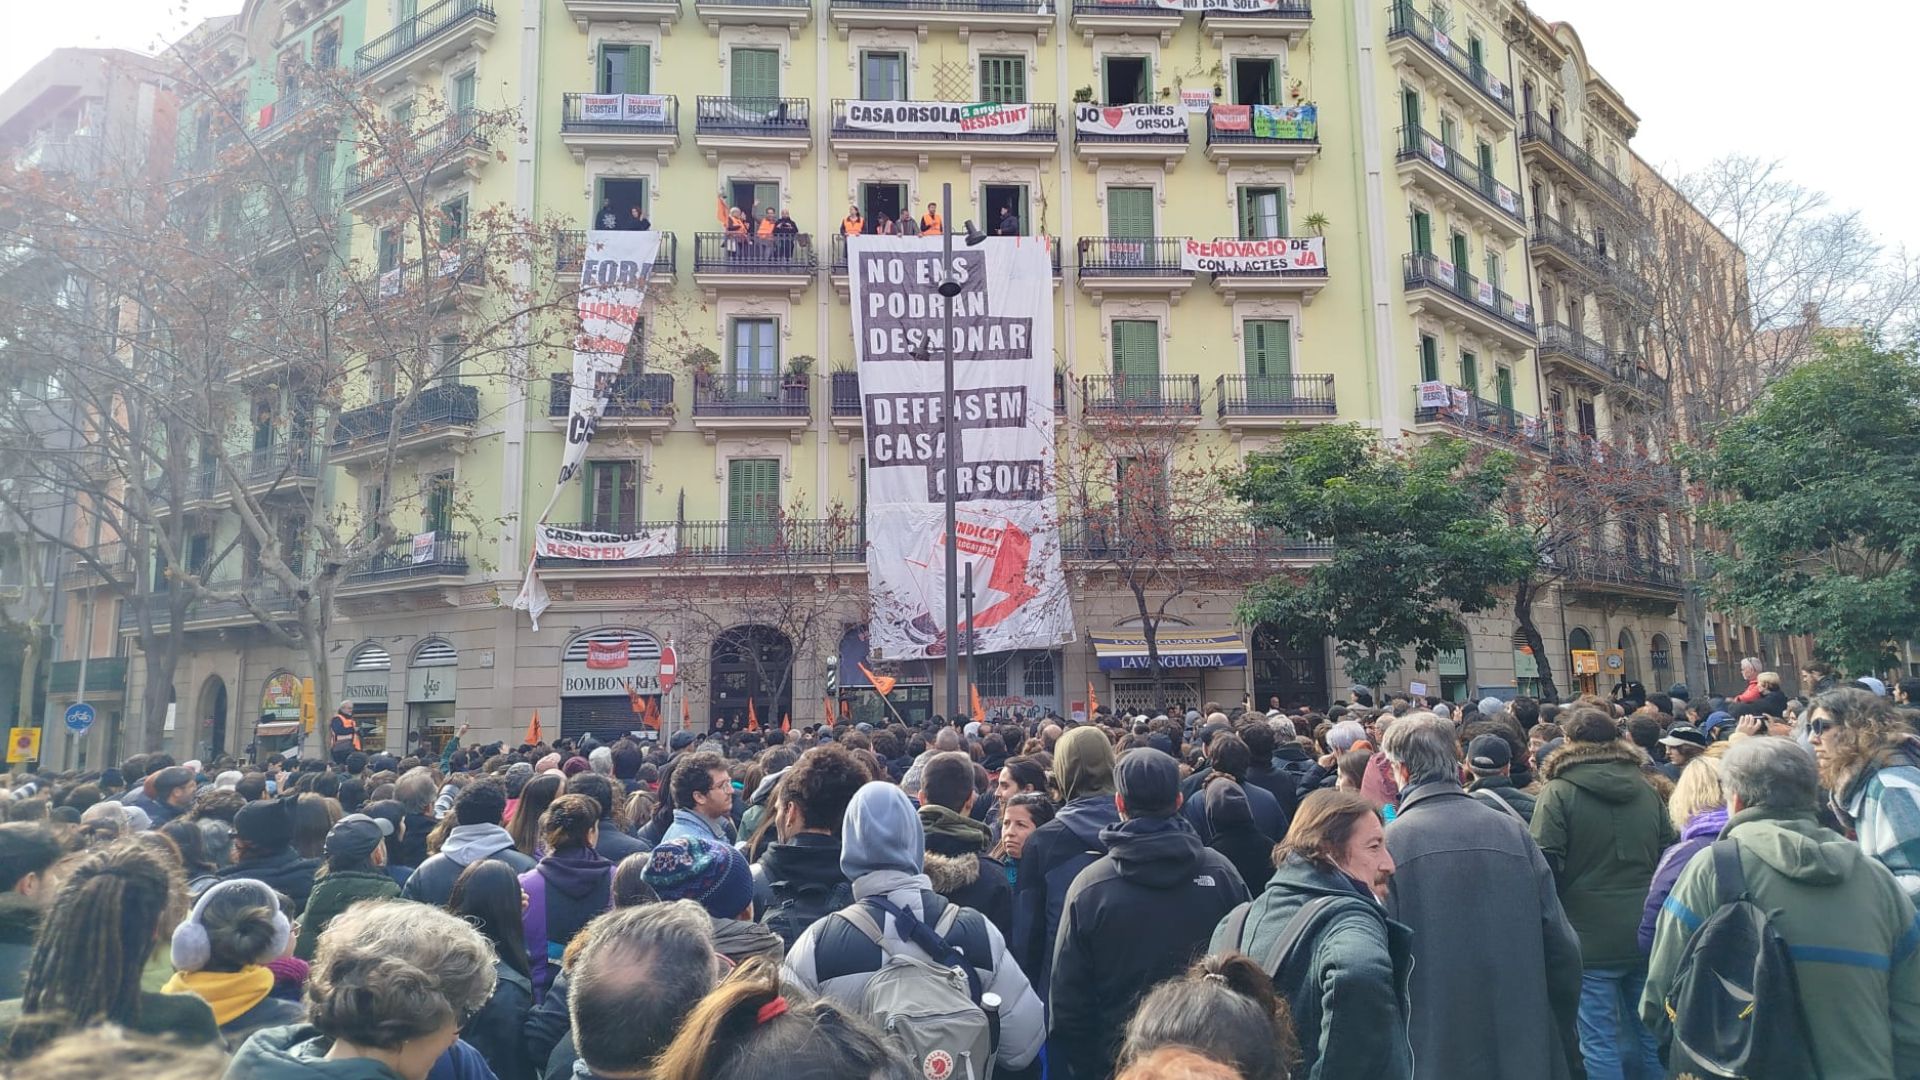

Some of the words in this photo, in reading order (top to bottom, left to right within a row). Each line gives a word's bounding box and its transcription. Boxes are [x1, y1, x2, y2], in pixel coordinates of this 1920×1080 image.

[1233, 0, 1260, 9] SOLA
[850, 106, 895, 123] CASA
[896, 106, 961, 123] ORSOLA
[960, 106, 1028, 132] RESISTINT
[961, 107, 970, 118] 2
[973, 106, 1002, 117] anys
[1076, 107, 1100, 123] JO
[1135, 117, 1186, 130] ORSOLA
[1291, 240, 1310, 251] DE
[1295, 251, 1318, 267] JA
[867, 258, 904, 285] NO
[916, 257, 968, 284] ENS
[869, 291, 985, 318] PODRAN
[869, 323, 1026, 355] DESNONAR
[875, 431, 947, 462] CASA
[936, 464, 1041, 495] ORSOLA
[545, 528, 585, 542] CASA
[588, 529, 651, 544] ORSOLA
[954, 520, 1003, 542] INDICAT
[546, 543, 626, 559] RESISTEIX
[1128, 637, 1217, 645] VAGUARDIA
[1121, 656, 1137, 669] LA
[346, 684, 388, 698] PASTISSERIA
[566, 675, 659, 691] BOMBONERIA
